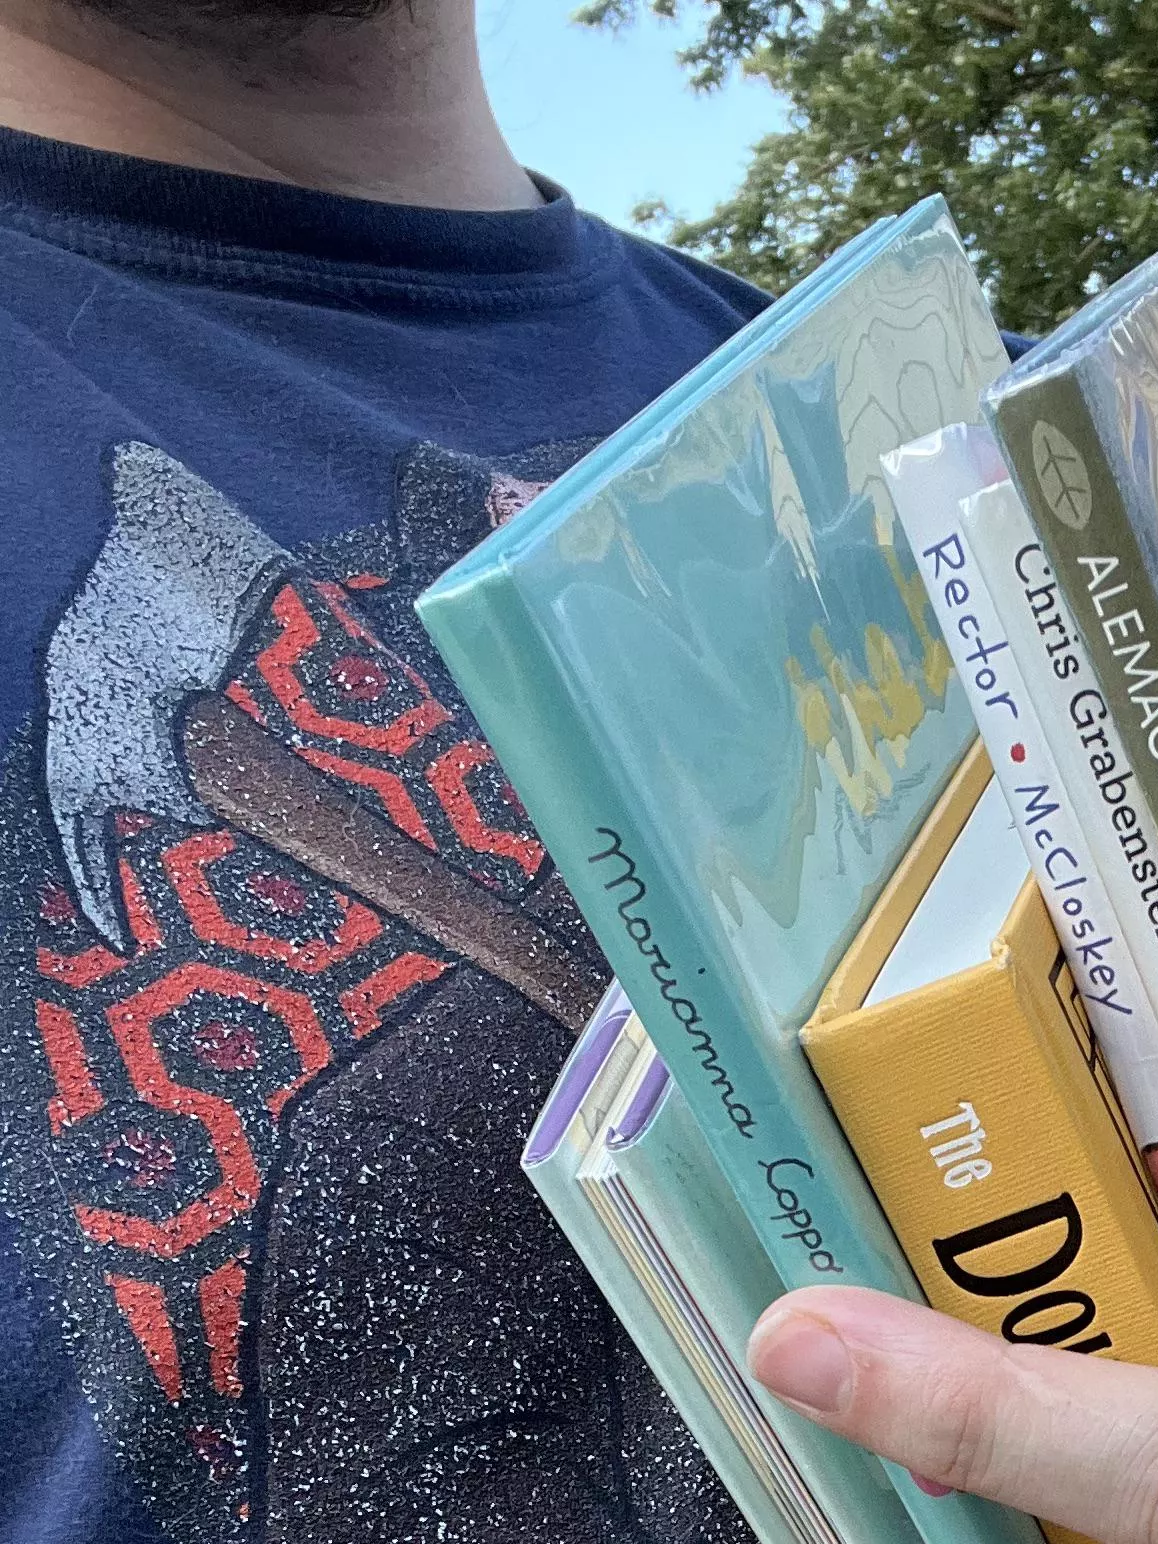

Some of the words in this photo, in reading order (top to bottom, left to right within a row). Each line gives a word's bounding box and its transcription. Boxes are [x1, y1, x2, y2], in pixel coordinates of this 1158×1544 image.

[1014, 542, 1081, 680] Chris
[923, 532, 1019, 720] Rector
[1014, 784, 1133, 1016] McCloskey
[588, 827, 756, 1139] Marianna
[758, 1158, 844, 1274] Coppo
[919, 1101, 993, 1189] The
